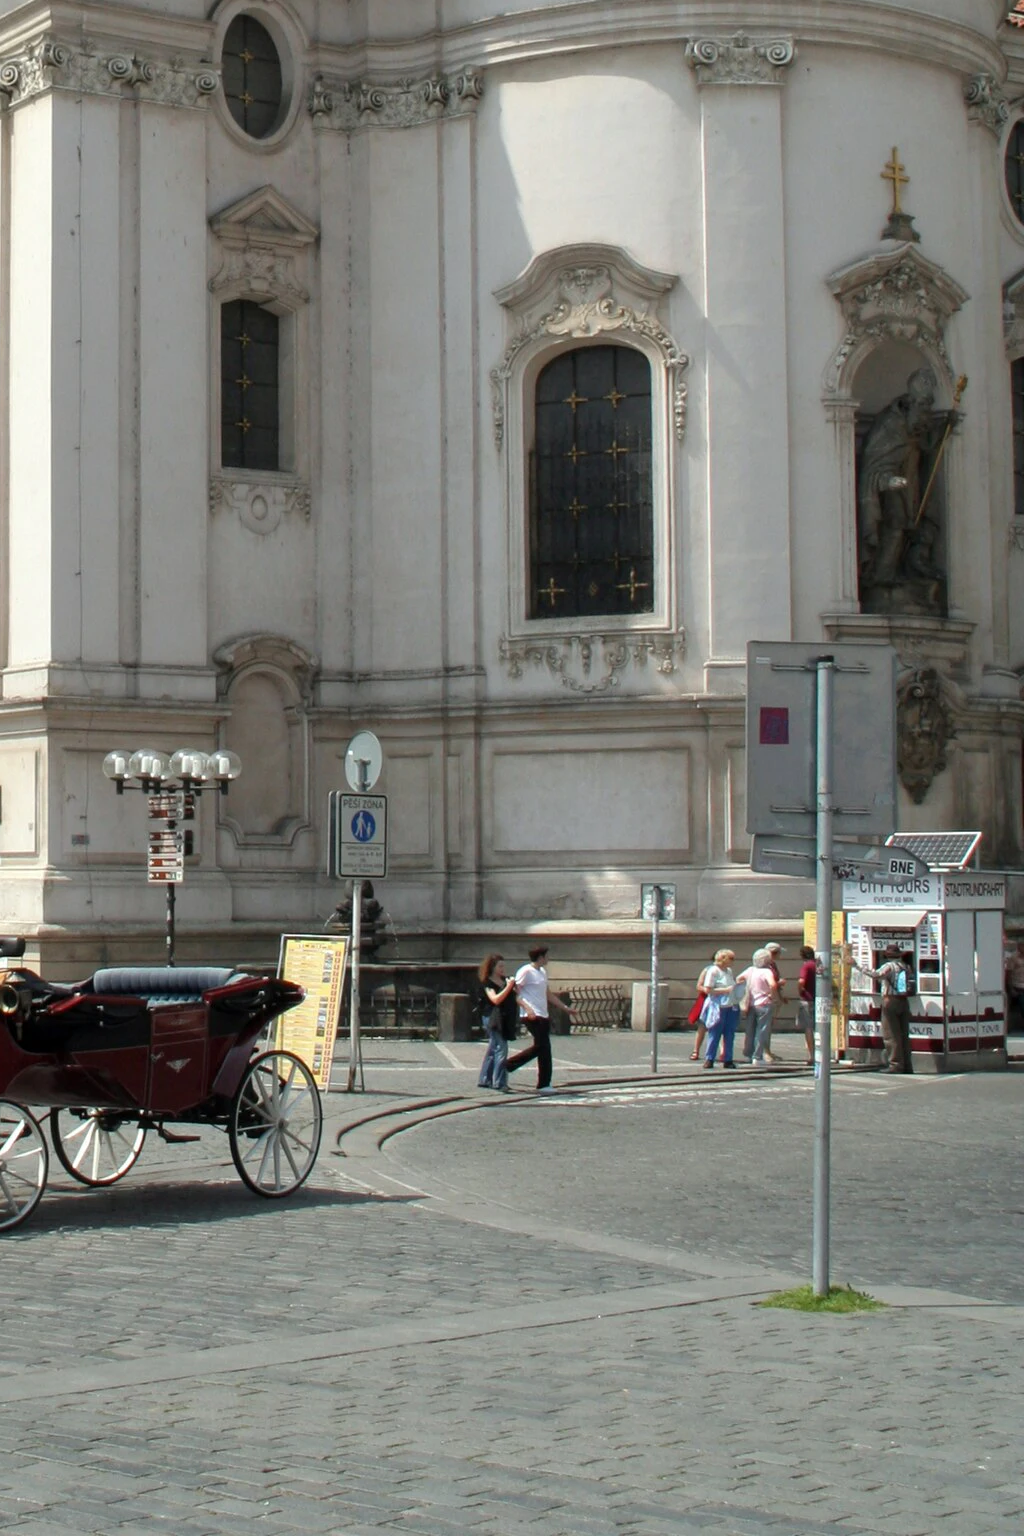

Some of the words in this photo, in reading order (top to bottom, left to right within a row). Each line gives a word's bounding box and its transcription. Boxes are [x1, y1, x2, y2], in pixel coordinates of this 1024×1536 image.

[890, 860, 914, 874] BNE
[860, 881, 884, 894] CITY
[890, 879, 930, 894] TOURS
[945, 882, 1004, 897] STADTRUNDFAHRT
[981, 1023, 1000, 1034] TOUR
